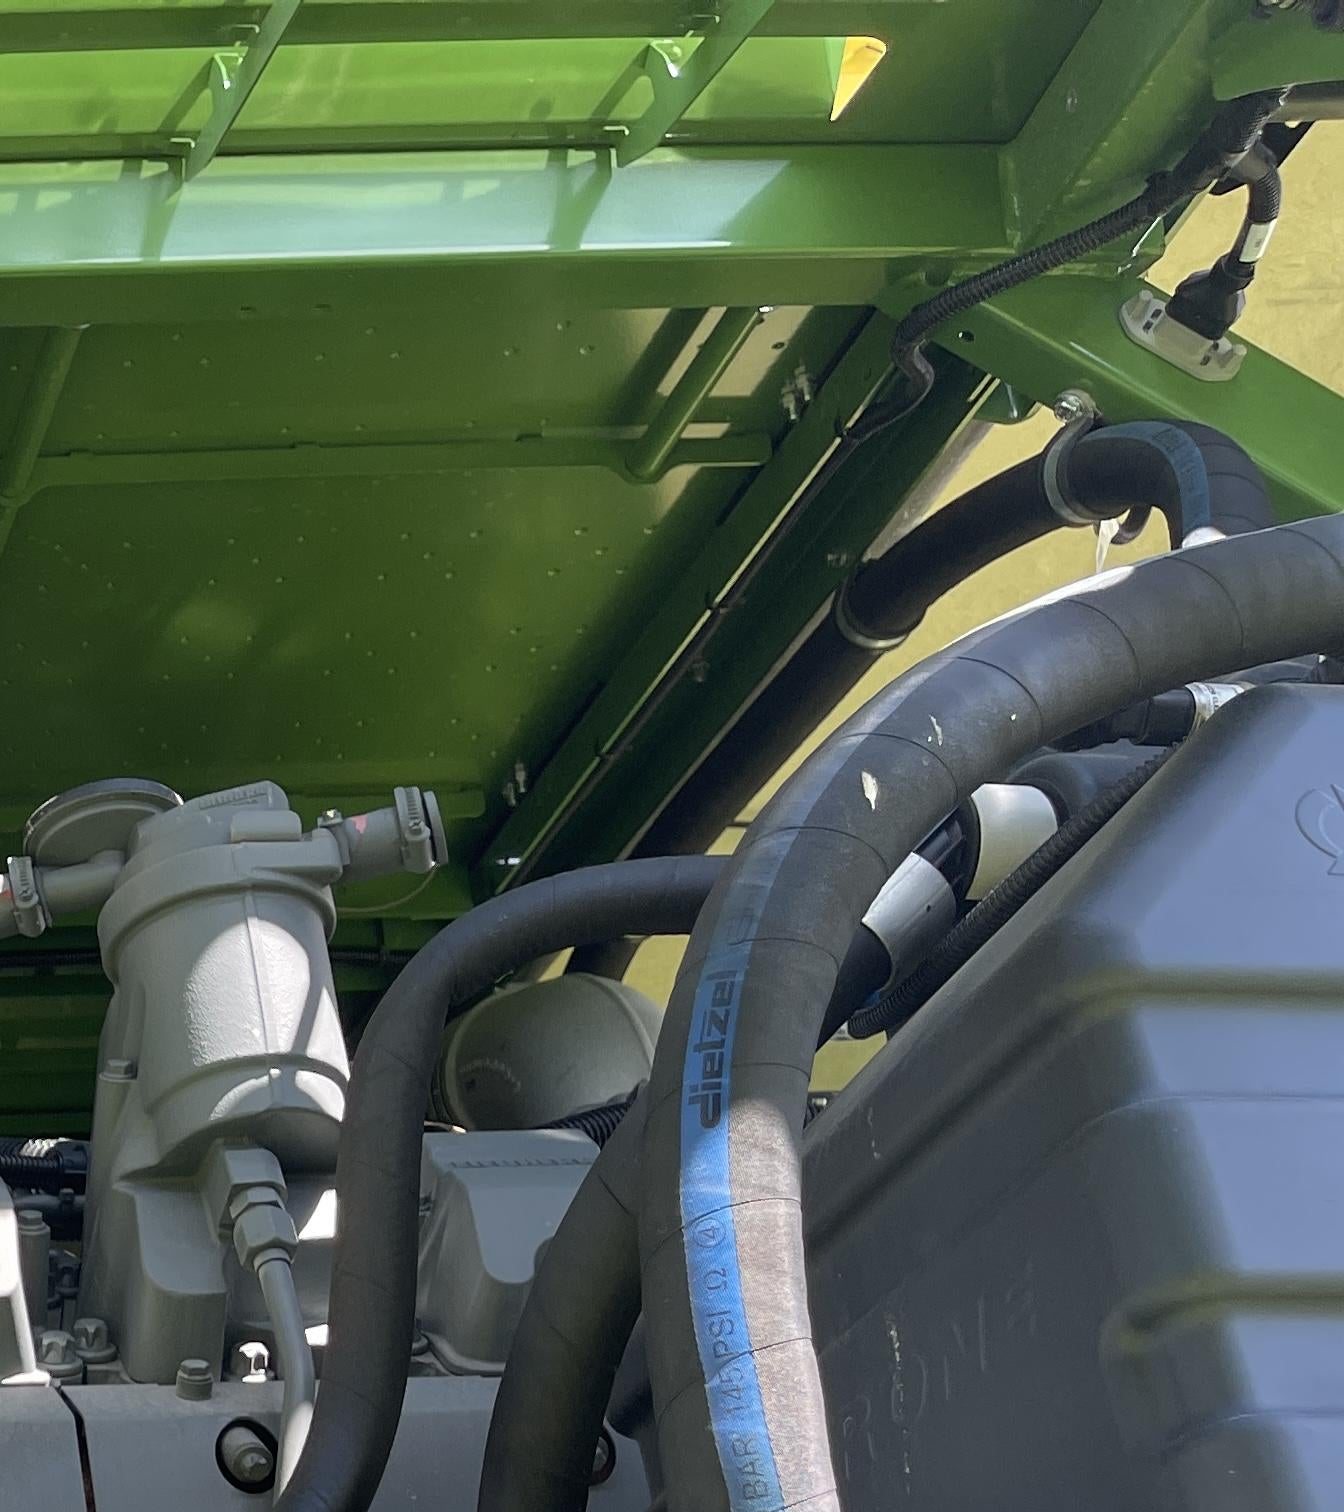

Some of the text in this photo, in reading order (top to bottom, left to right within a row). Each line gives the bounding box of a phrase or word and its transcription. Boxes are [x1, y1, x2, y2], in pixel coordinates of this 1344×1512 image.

[688, 969, 737, 1129] dietzel
[707, 1311, 734, 1360] PSI
[717, 1366, 750, 1416] 145
[733, 1433, 769, 1501] BAR
